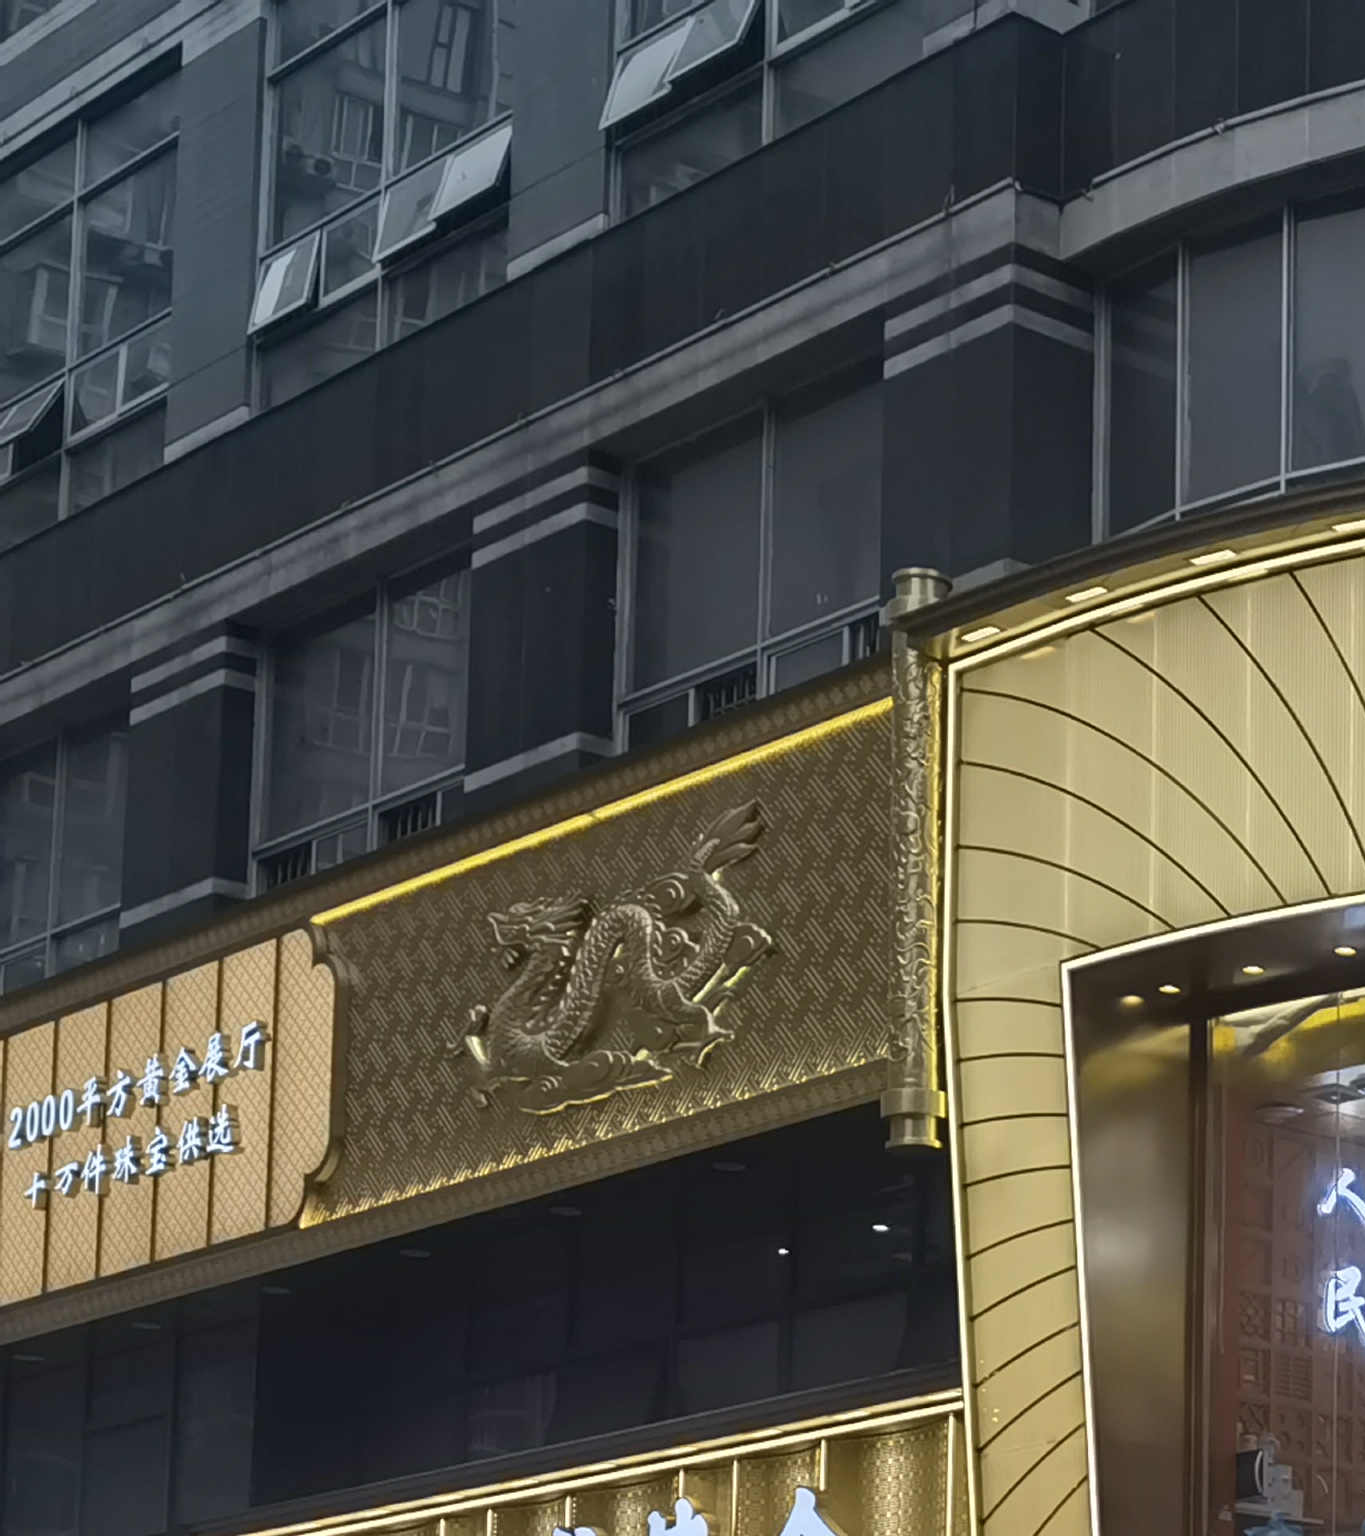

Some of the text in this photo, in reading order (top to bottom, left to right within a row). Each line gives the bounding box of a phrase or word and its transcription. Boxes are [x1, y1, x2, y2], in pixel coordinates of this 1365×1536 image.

[8, 1021, 263, 1149] 2000平方黄金展厅
[24, 1104, 234, 1208] 十万件珠宝供选
